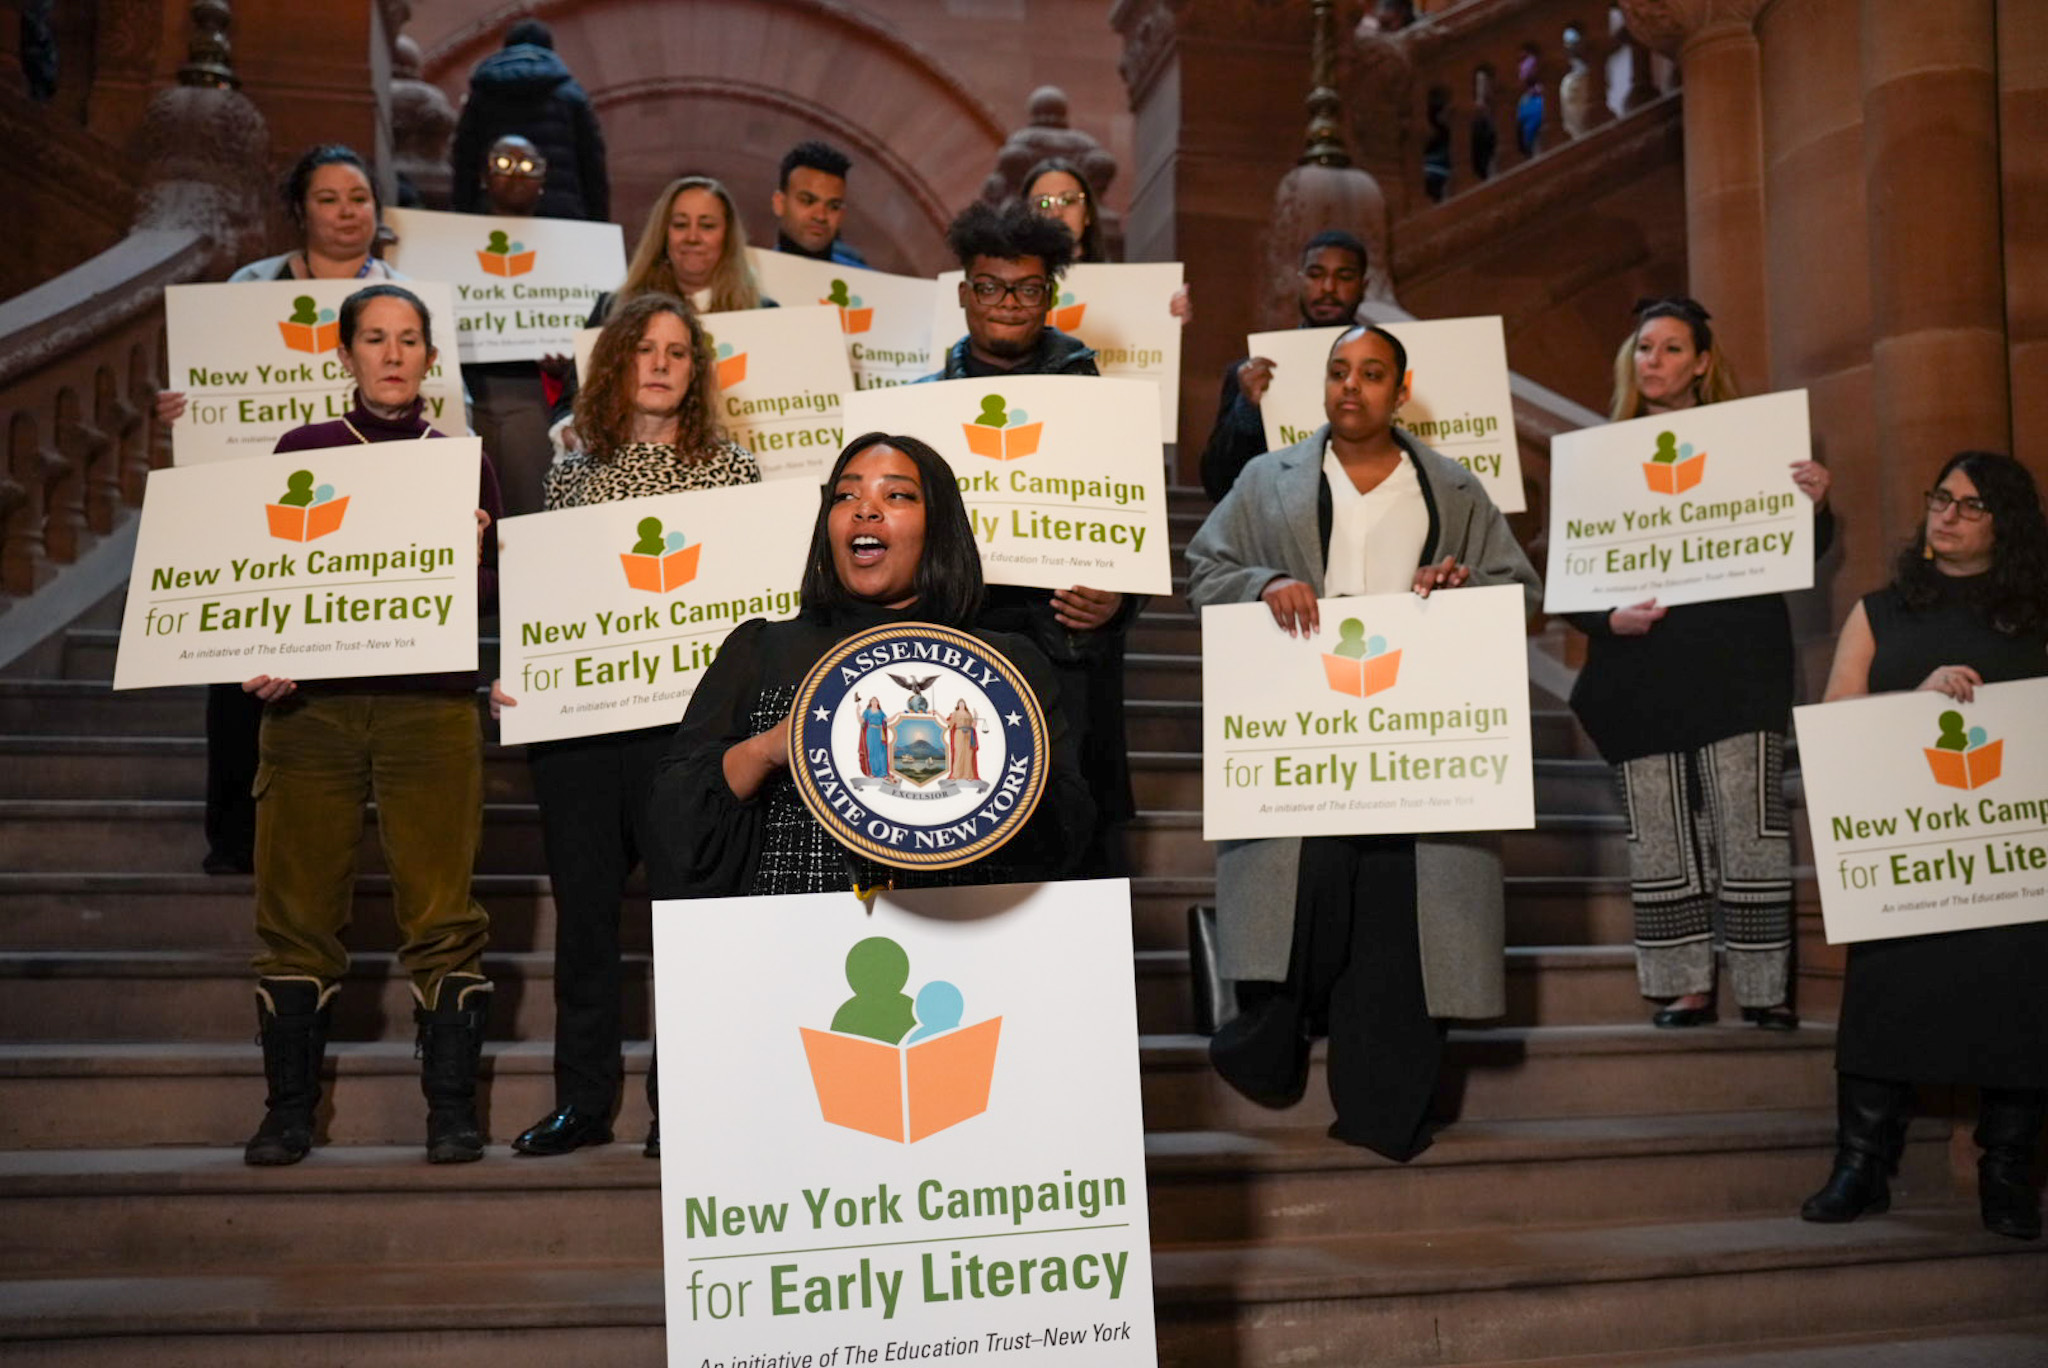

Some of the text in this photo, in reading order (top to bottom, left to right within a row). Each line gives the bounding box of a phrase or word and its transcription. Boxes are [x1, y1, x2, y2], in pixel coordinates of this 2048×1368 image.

[457, 284, 506, 300] York
[458, 310, 588, 334] arly Litera
[189, 367, 248, 387] New
[257, 362, 314, 385] York
[1102, 344, 1163, 368] paign
[191, 400, 228, 424] for
[238, 397, 314, 424] Early
[726, 389, 840, 416] Campaign
[1280, 425, 1313, 444] Ne
[957, 470, 1145, 504] ork Campaign
[1011, 509, 1146, 552] Literacy
[1566, 490, 1794, 539] New York Campaign
[150, 543, 454, 591] New York Campaign
[990, 552, 1038, 564] Education
[1095, 557, 1115, 569] York
[1564, 530, 1794, 576] for Early Literacy
[145, 592, 453, 637] for Early Literacy
[521, 621, 587, 646] New
[596, 606, 660, 635] York
[178, 649, 195, 660] An
[197, 647, 241, 658] initiative
[243, 645, 255, 656] of
[257, 644, 277, 655] The
[279, 641, 332, 654] Education
[394, 637, 416, 647] York
[839, 641, 1000, 689] ASSEMBLY
[521, 663, 563, 693] for
[574, 650, 660, 687] Early
[560, 687, 694, 715] An initiative of The Educatio
[1223, 702, 1508, 740] New York Campaign
[1223, 751, 1509, 791] for Early Literacy
[808, 747, 1029, 849] STATE OF NEW YORK
[891, 788, 949, 800] EXCELSIOR
[1259, 803, 1273, 813] An
[1275, 802, 1314, 814] initiative
[1316, 801, 1328, 812] of
[1329, 800, 1347, 811] The
[1349, 798, 1397, 811] Education
[1832, 798, 2048, 841] New York Camp
[1838, 841, 2048, 890] for Early Lite
[1881, 903, 1896, 913] An
[1897, 899, 1937, 912] initiative
[1940, 896, 1950, 907] of
[1952, 894, 1970, 906] The
[1972, 889, 2019, 904] Education
[685, 1169, 1127, 1239] New York Campaign
[686, 1250, 1130, 1321] for Early Literacy
[731, 1351, 813, 1368] initiative
[819, 1347, 838, 1367] of
[844, 1343, 879, 1366] The
[885, 1336, 980, 1363] Education
[1093, 1321, 1132, 1343] York
